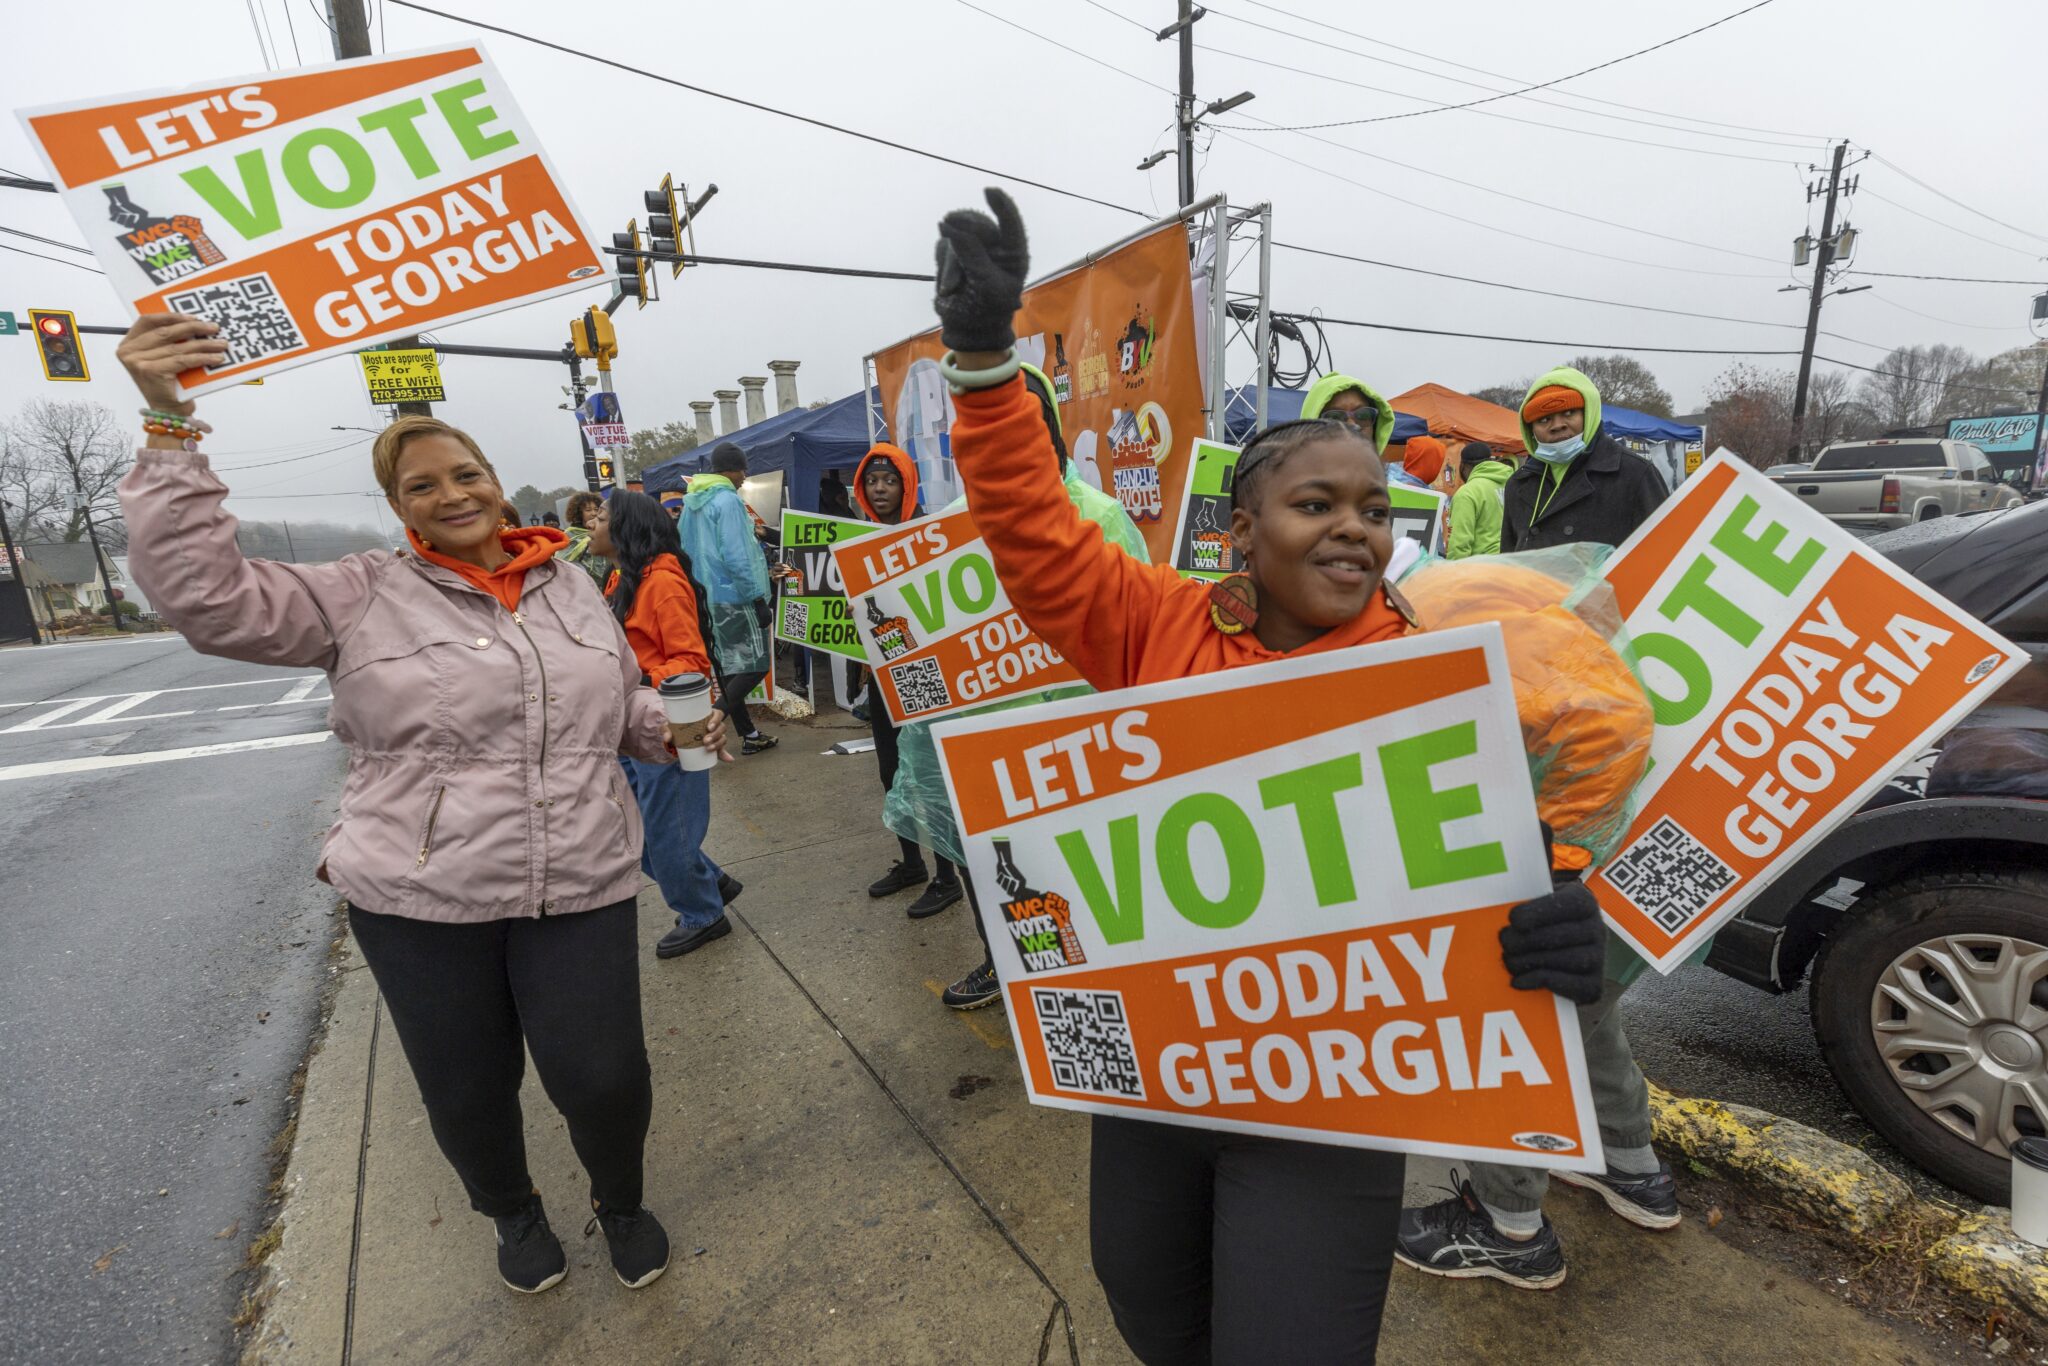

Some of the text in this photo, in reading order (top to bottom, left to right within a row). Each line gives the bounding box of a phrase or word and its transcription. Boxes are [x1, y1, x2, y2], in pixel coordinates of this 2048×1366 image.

[99, 87, 277, 169] LET'S
[180, 78, 519, 240] VOTE
[127, 223, 173, 246] we
[314, 175, 510, 276] TODAY
[128, 232, 191, 262] VOTE
[147, 244, 192, 269] we
[313, 210, 576, 338] GEORGIA
[363, 352, 433, 366] Most are approved
[390, 366, 411, 375] for
[370, 376, 439, 389] FREE WiFi!
[372, 388, 442, 399] 470-995-1115
[586, 426, 604, 436] VOTE
[1950, 418, 2037, 441] Chill Latte
[1114, 467, 1160, 489] STAND-UP
[794, 521, 838, 545] LET'S
[1198, 532, 1220, 542] we
[863, 523, 949, 585] LET'S
[1192, 541, 1222, 551] VOTE
[1197, 549, 1219, 559] we
[898, 553, 997, 635] VO
[1628, 495, 1827, 728] OTE
[875, 627, 903, 645] VOTE
[1690, 597, 1861, 788] TODAY
[1724, 613, 1955, 859] GEORGIA
[992, 710, 1162, 818] LET'S
[1054, 720, 1509, 946] VOTE
[1008, 897, 1045, 920] we
[1008, 914, 1058, 939] VOTE
[1021, 931, 1058, 953] we
[1174, 925, 1456, 1028] TODAY
[1159, 1010, 1553, 1108] GEORGIA
